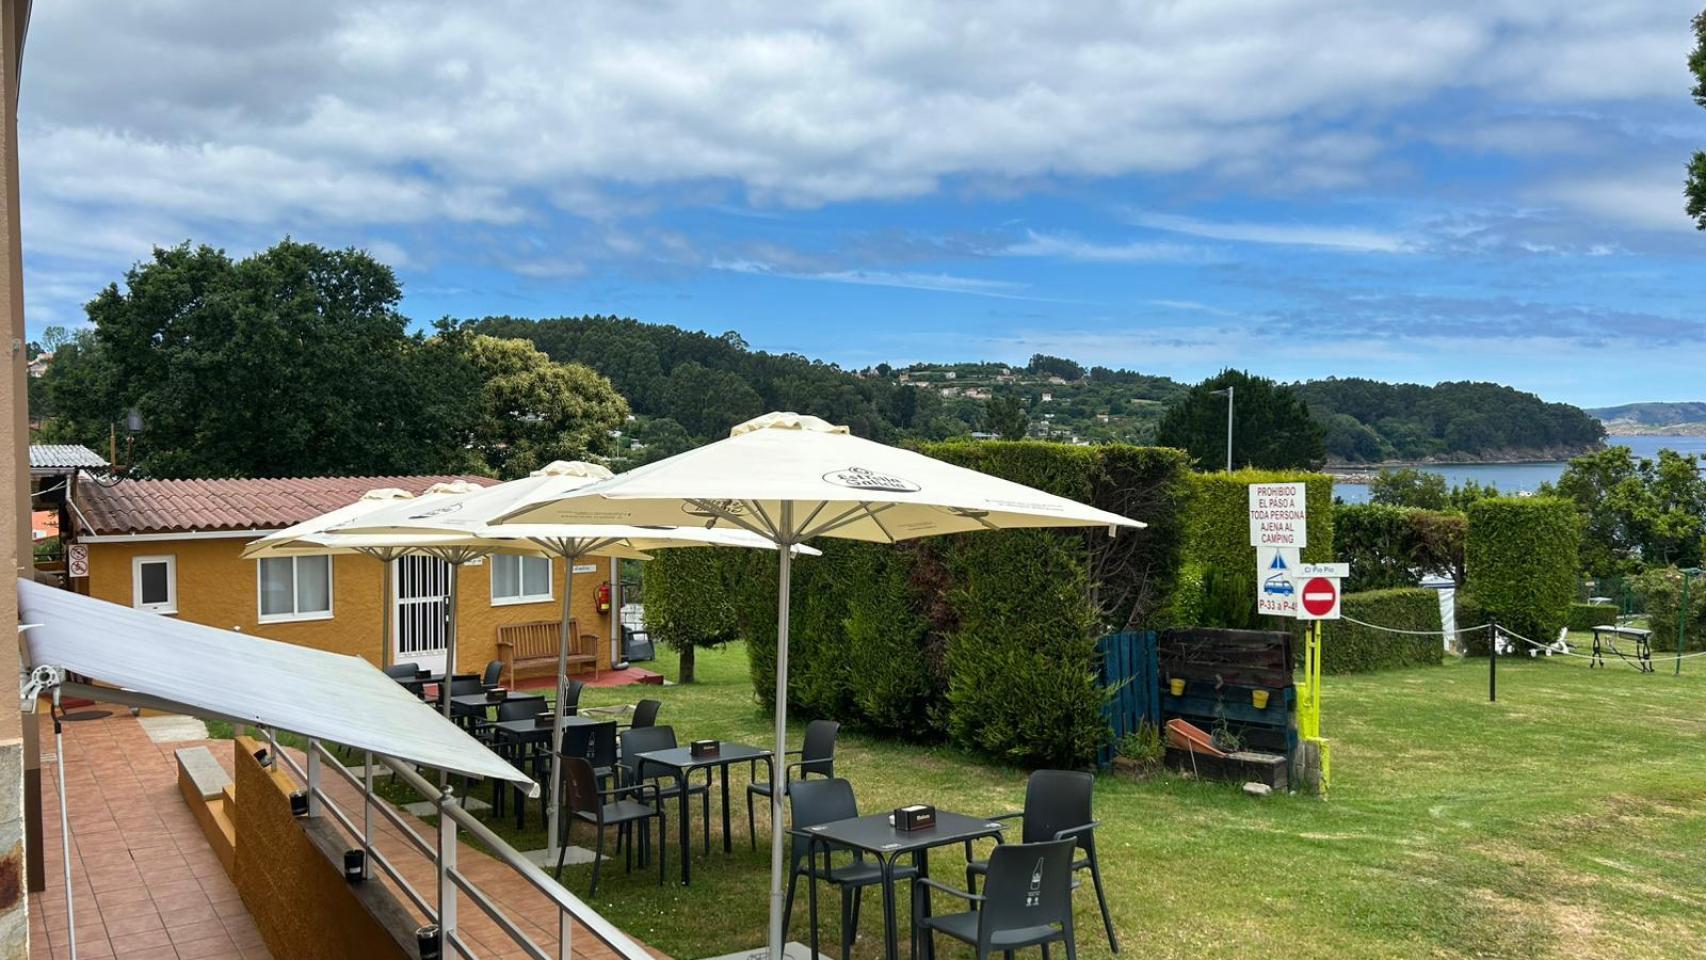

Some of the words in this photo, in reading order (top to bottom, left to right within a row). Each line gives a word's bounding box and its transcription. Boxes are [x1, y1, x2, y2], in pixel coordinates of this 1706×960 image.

[846, 479, 906, 489] Galicia
[1257, 487, 1296, 496] PROHIBIDO
[1259, 499, 1268, 508] EL
[1269, 498, 1288, 508] PASO
[1289, 499, 1295, 508] A
[1250, 511, 1269, 520] TODA
[1270, 510, 1305, 520] PERSONA
[1261, 522, 1284, 532] AJENA
[1285, 522, 1295, 532] AL
[1261, 533, 1294, 544] CAMPING
[1259, 600, 1275, 611] P-33
